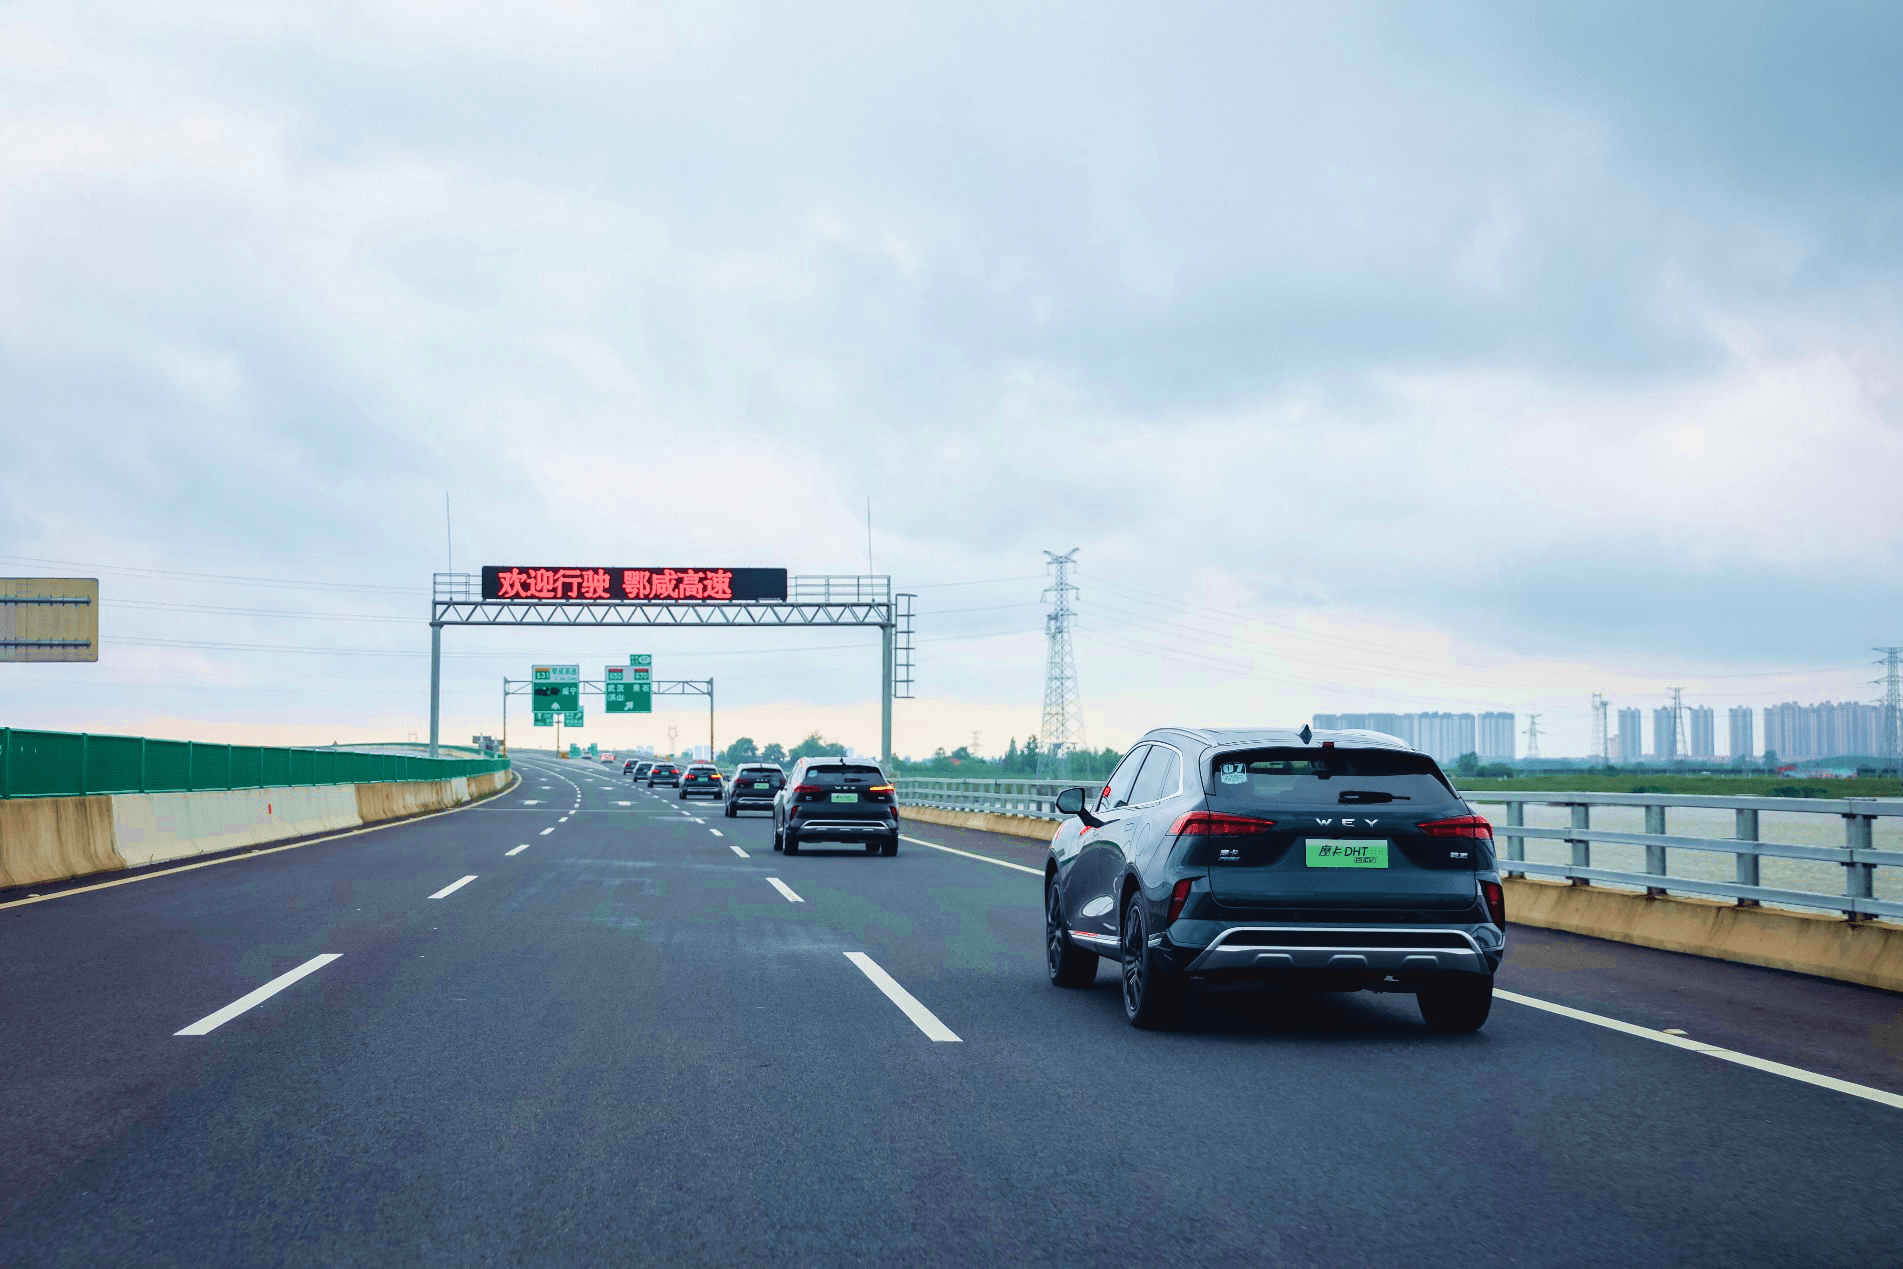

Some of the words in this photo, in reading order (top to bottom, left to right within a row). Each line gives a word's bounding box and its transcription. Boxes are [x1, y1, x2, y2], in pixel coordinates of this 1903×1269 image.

[498, 568, 610, 599] 欢迎行驶
[622, 570, 732, 599] 鄂咸高速
[1222, 763, 1243, 773] 07
[1315, 818, 1379, 827] WEY
